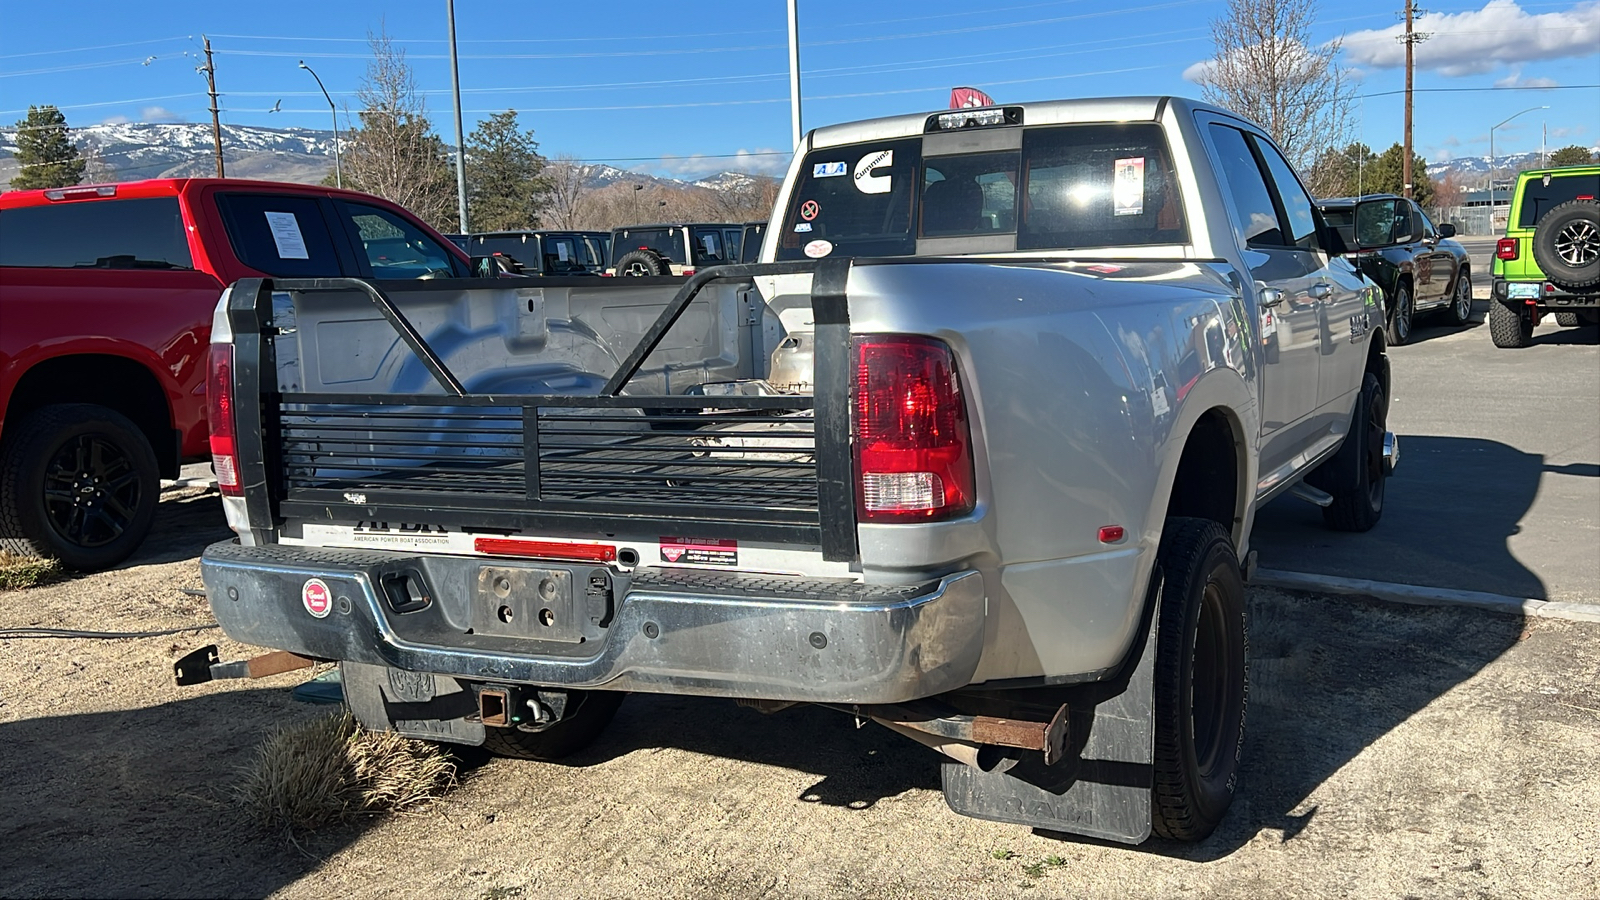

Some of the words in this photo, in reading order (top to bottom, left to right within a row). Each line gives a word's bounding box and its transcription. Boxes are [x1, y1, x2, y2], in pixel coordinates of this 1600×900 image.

[854, 151, 889, 181] Cummins
[307, 591, 325, 600] Good
[310, 599, 324, 607] Sam
[1003, 797, 1092, 824] RAM
